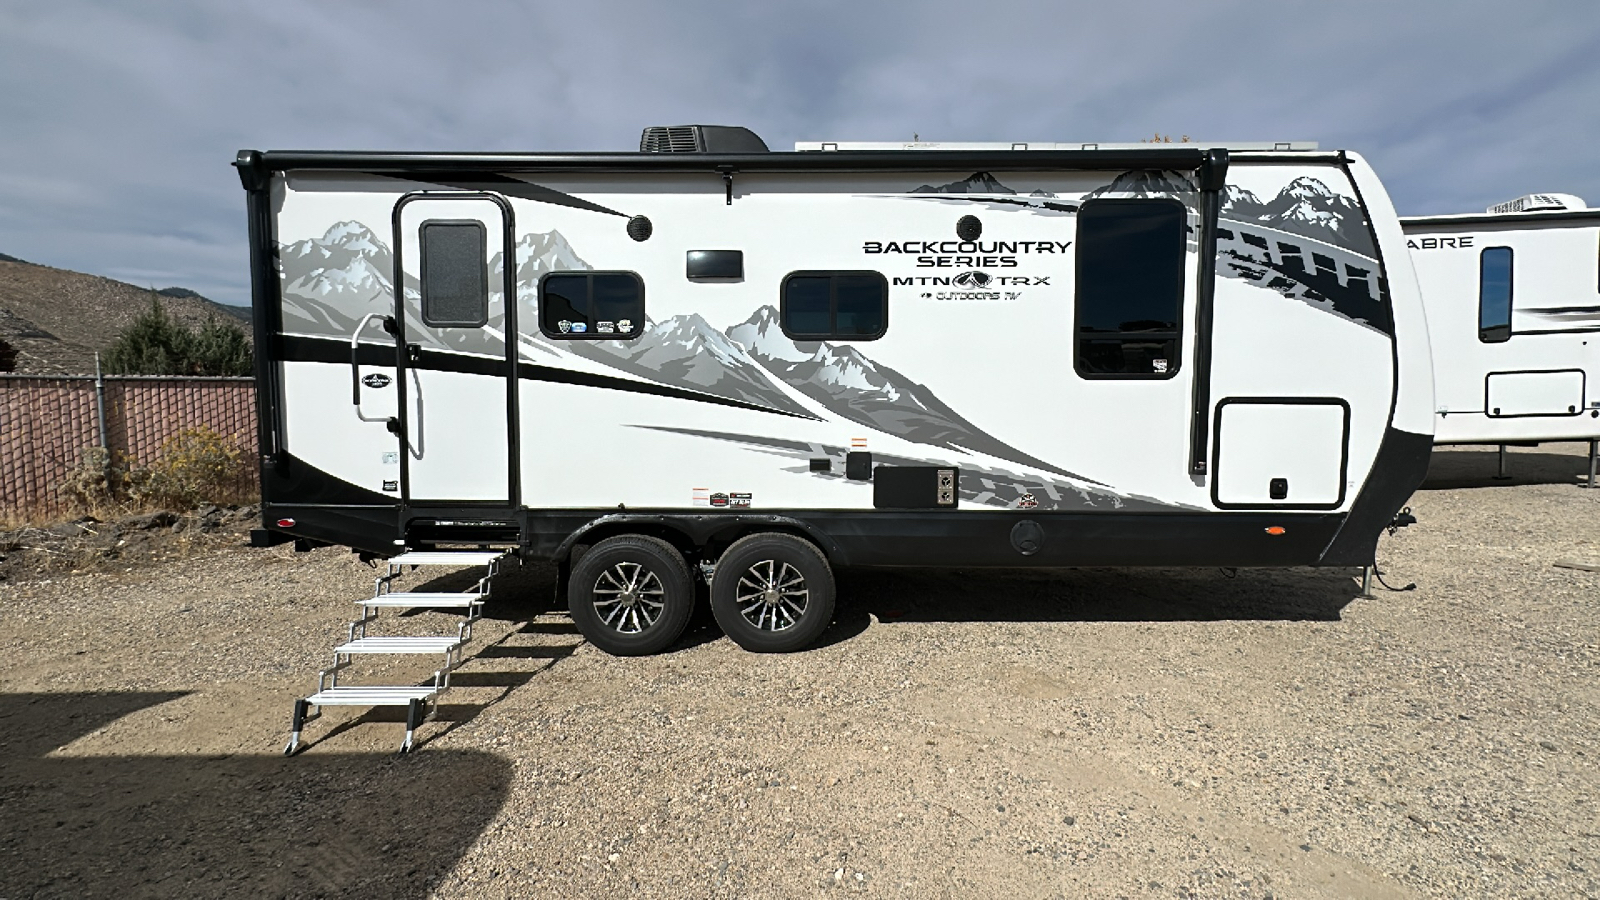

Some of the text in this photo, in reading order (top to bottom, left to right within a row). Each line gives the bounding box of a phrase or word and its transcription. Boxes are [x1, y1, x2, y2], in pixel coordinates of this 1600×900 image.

[862, 241, 1073, 254] BACKCOUNTRY
[1406, 236, 1474, 249] ABRE
[916, 256, 1018, 267] SERIES
[893, 276, 1051, 286] MTN TRX
[936, 291, 1022, 300] OUTDOORS RV
